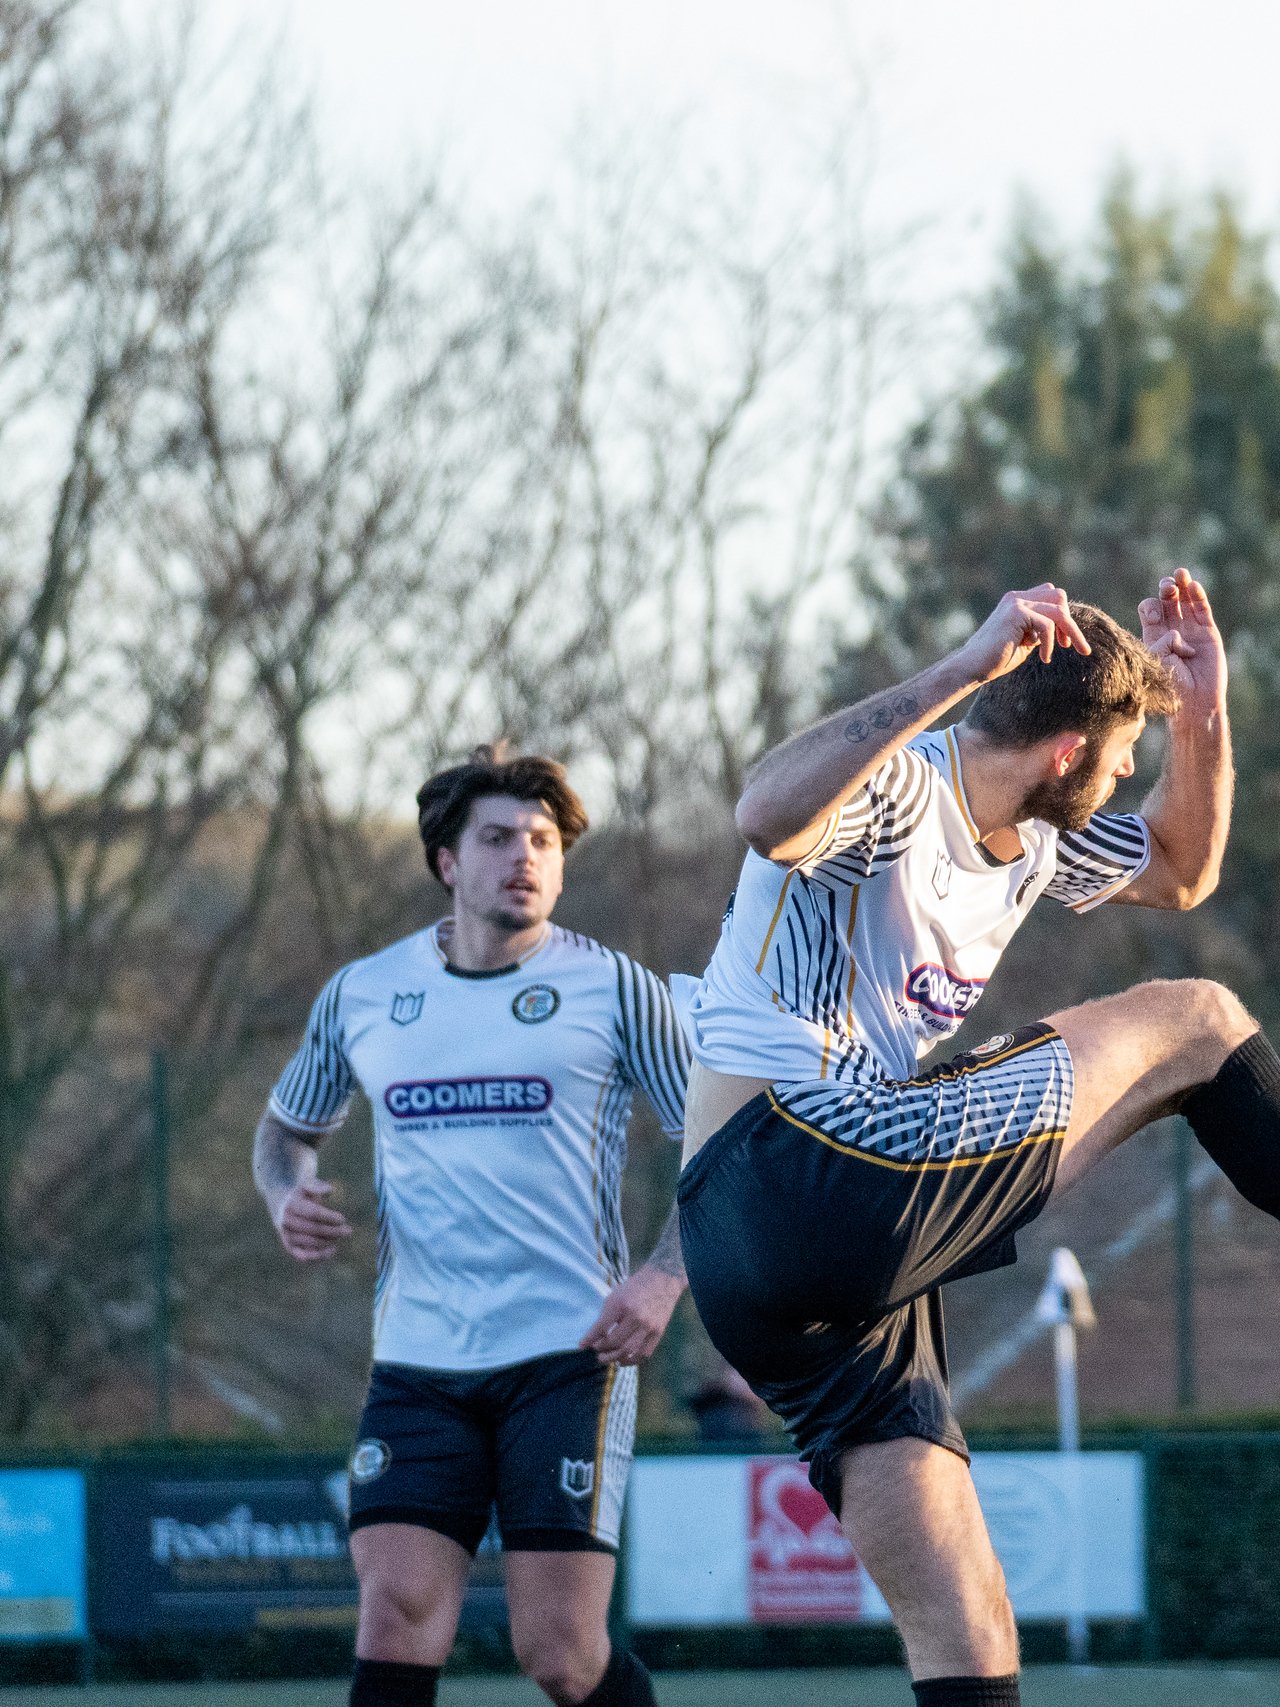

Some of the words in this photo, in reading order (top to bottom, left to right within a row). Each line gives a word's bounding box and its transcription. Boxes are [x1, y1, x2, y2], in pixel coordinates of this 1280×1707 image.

[390, 1081, 547, 1112] COOMERS
[444, 1118, 496, 1129] BUILDING
[499, 1117, 553, 1128] SUPPLIES
